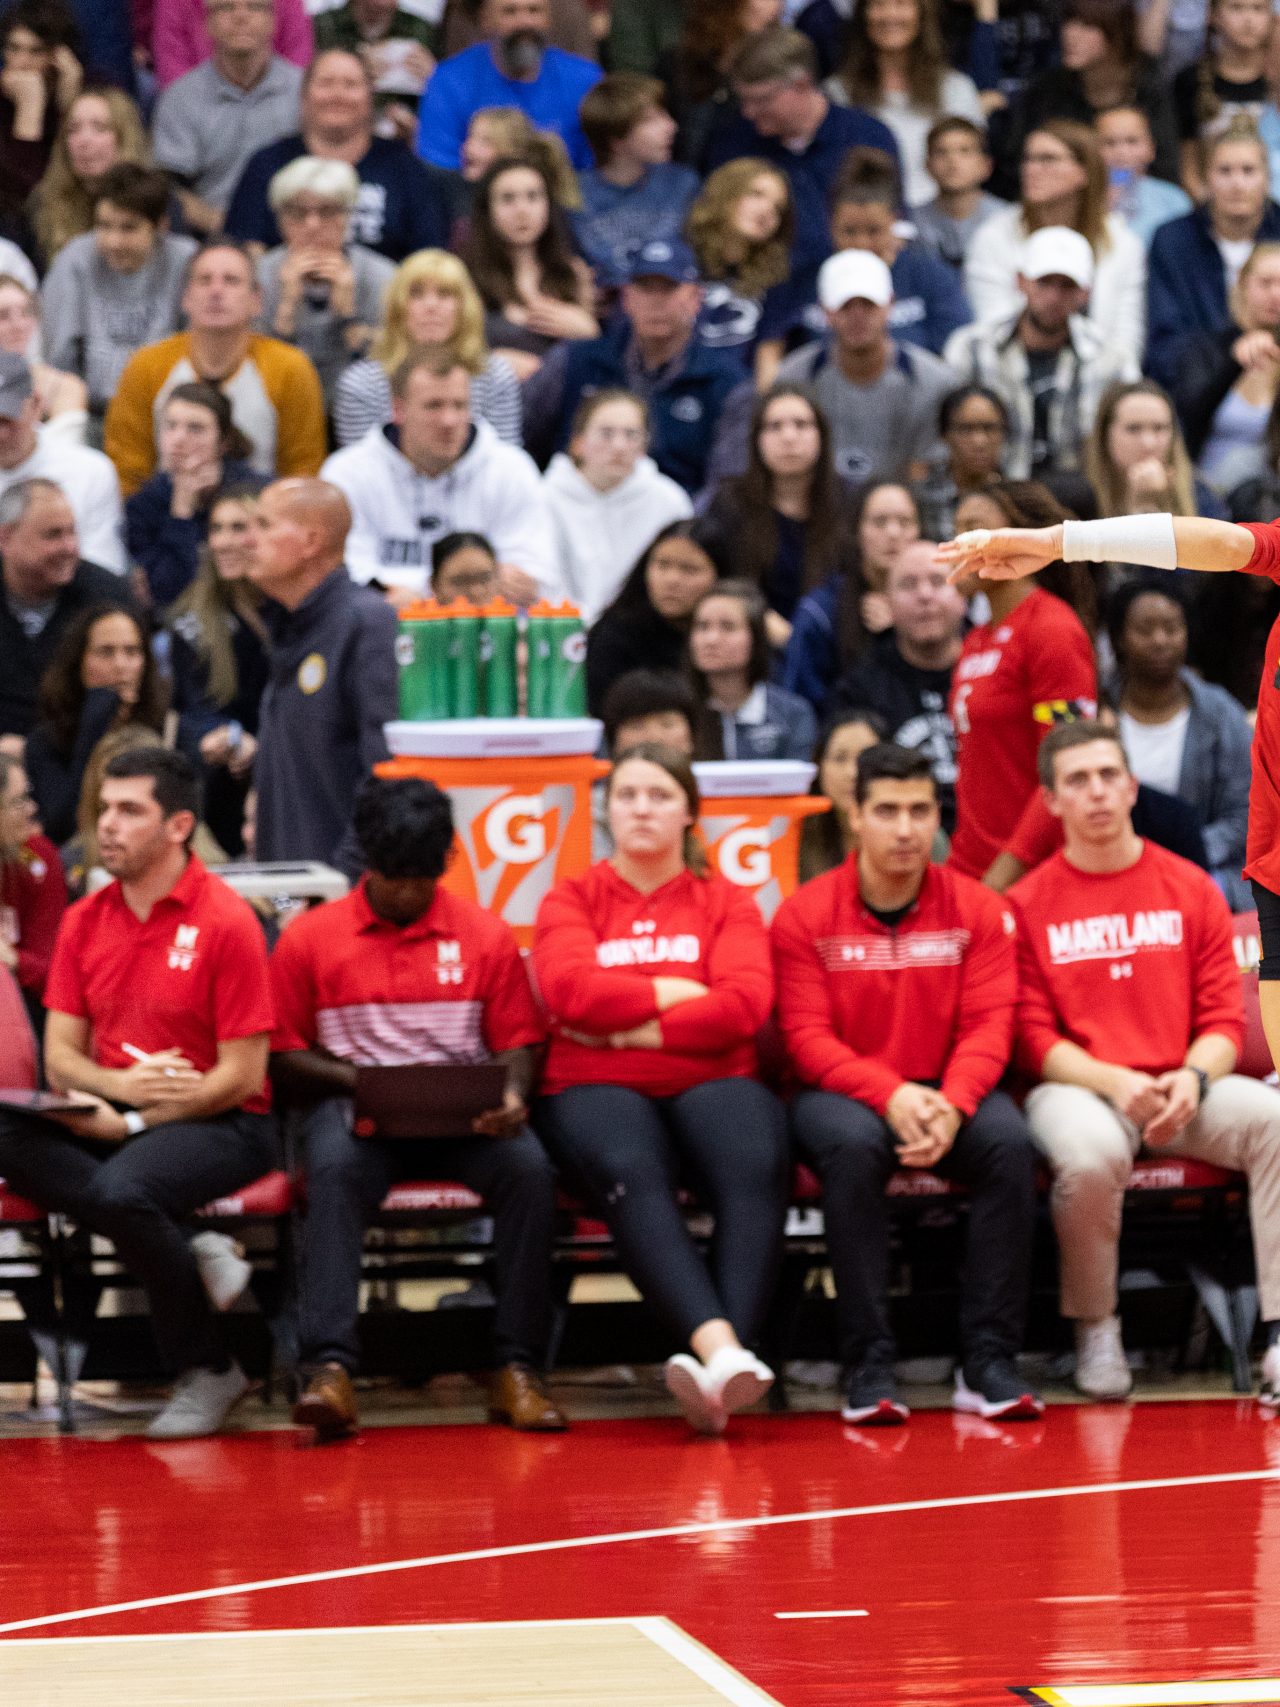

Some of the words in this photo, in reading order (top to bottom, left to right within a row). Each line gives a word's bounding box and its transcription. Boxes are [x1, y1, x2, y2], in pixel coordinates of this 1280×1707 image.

[484, 796, 547, 864] G
[718, 828, 772, 886] G
[1047, 909, 1184, 955] MARYLAND
